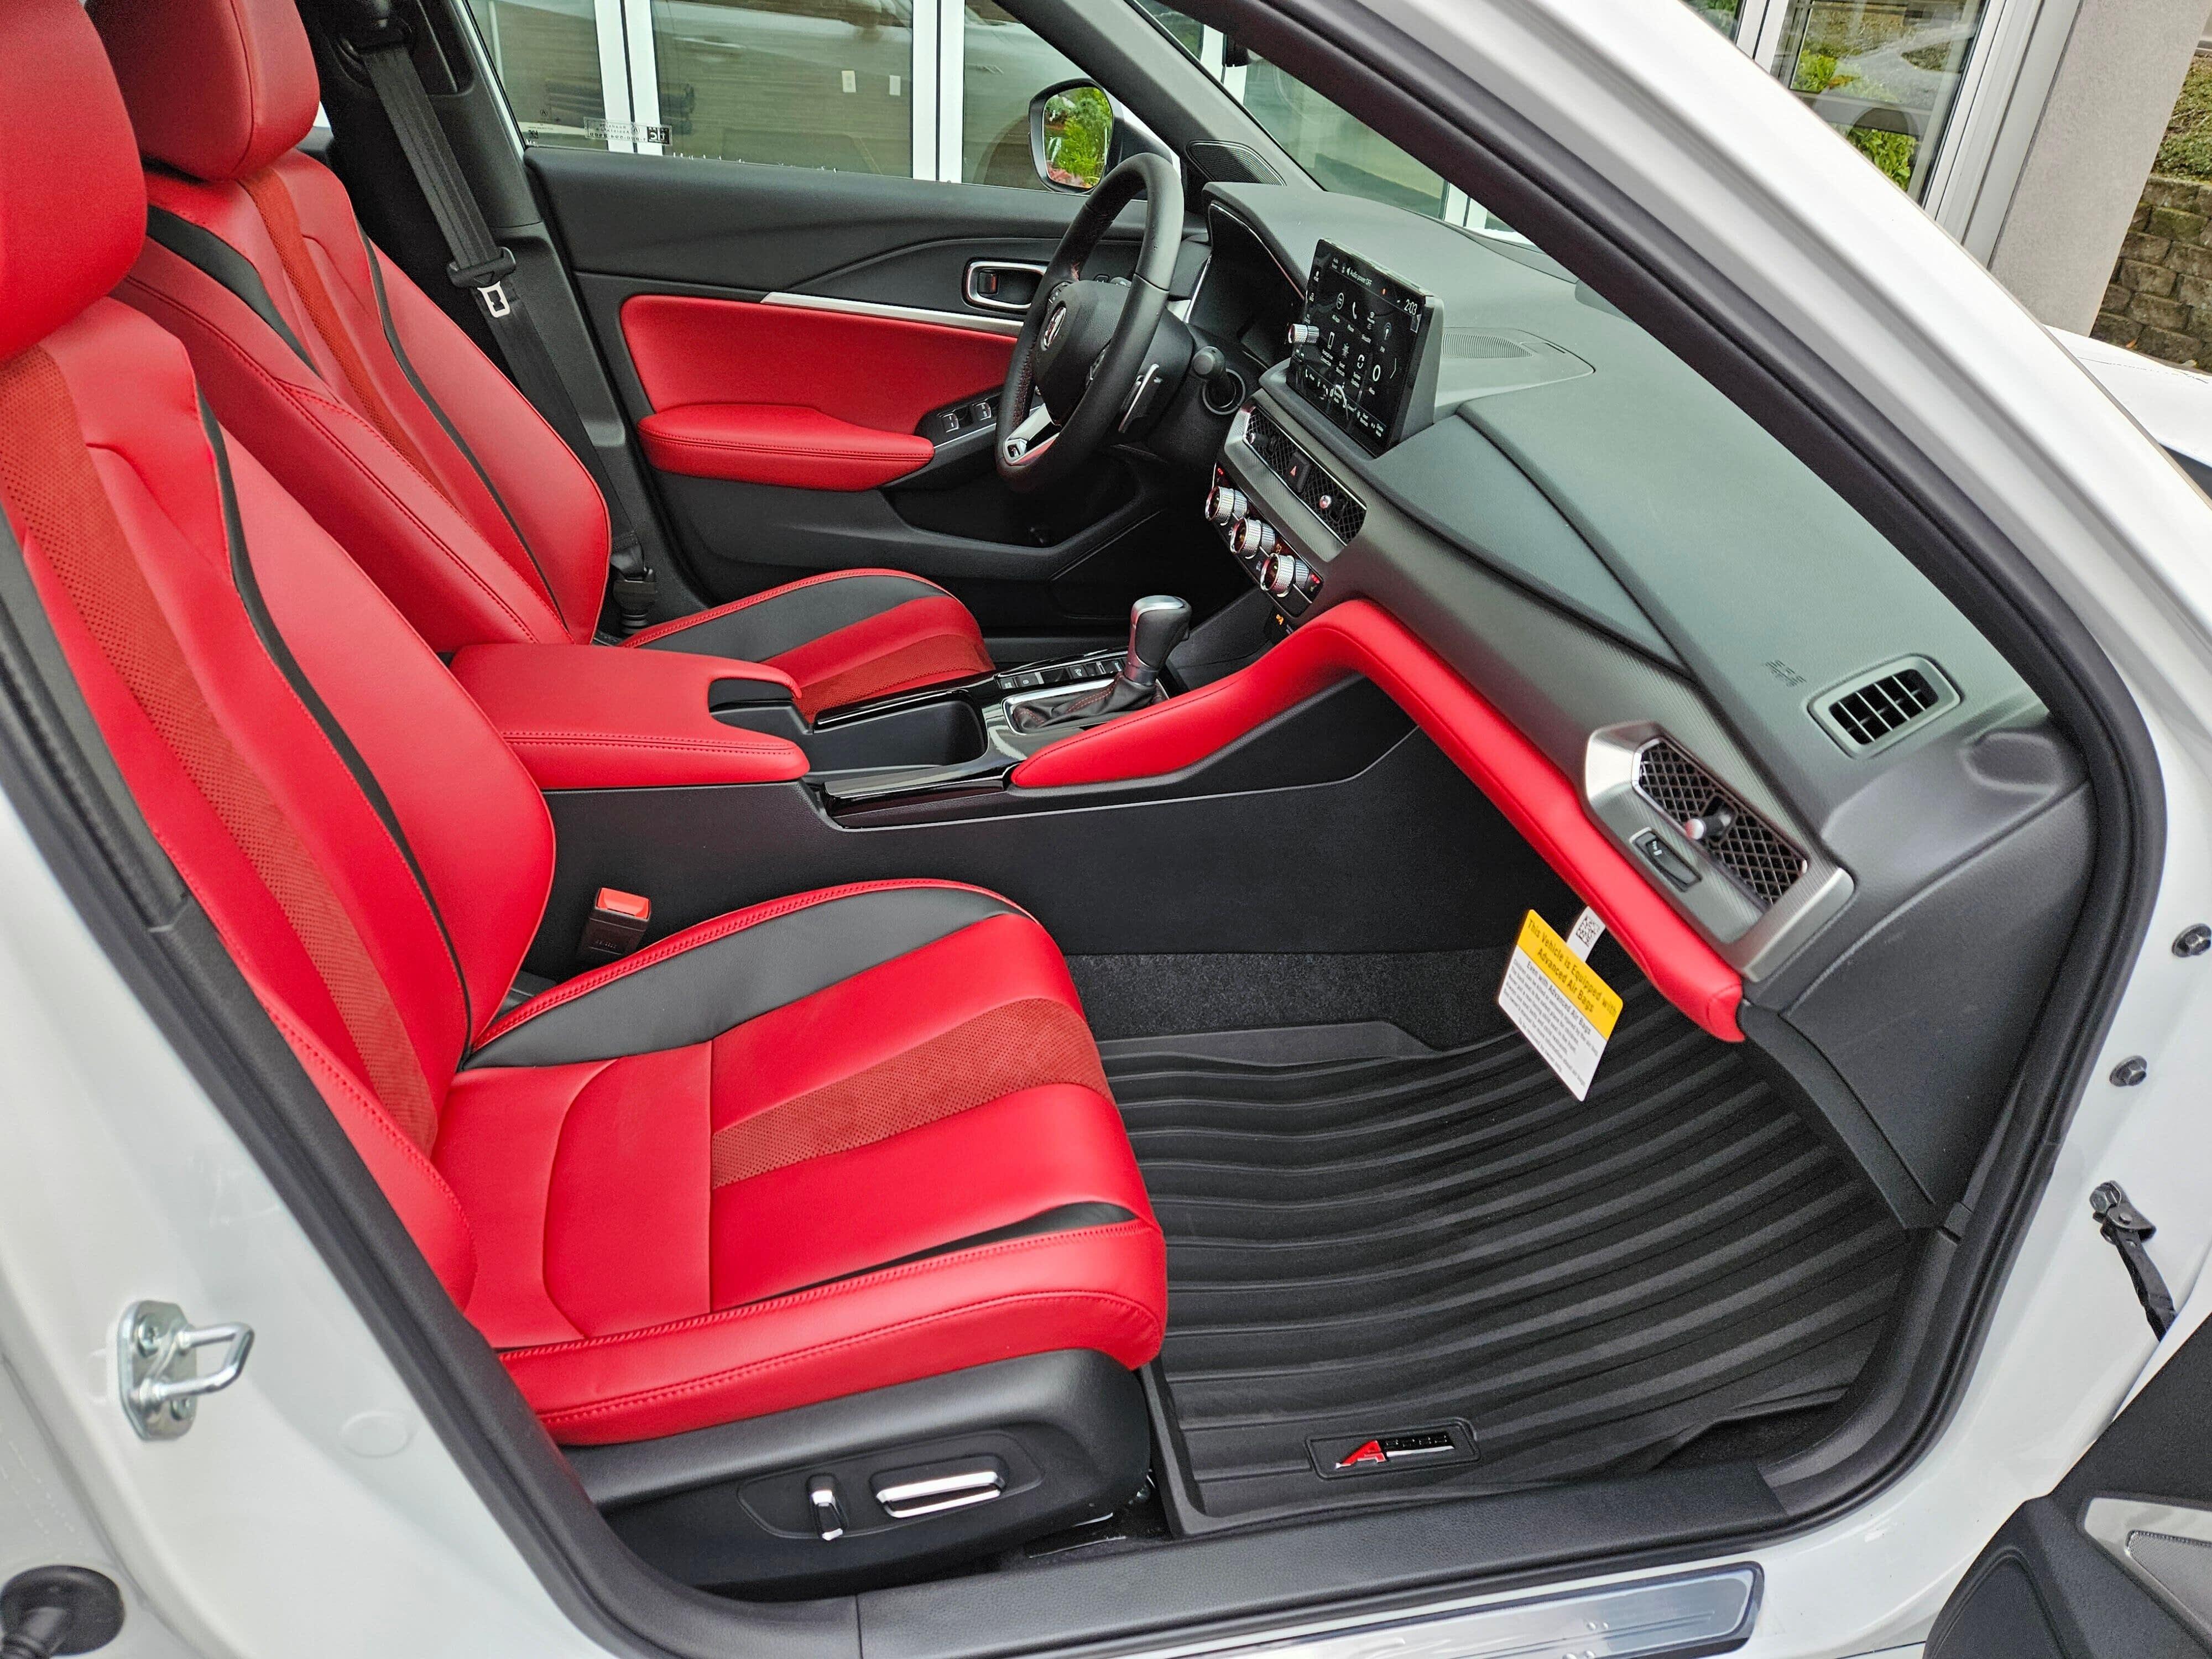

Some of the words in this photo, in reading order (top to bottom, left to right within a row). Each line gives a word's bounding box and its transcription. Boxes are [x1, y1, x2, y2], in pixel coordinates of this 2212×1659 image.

[1404, 299, 1417, 315] 2:03
[1526, 961, 1538, 978] Even
[1538, 973, 1548, 988] with
[1548, 983, 1571, 1013] Advanced
[1571, 1008, 1579, 1021] Air
[1578, 1017, 1592, 1036] Bags
[1527, 918, 1541, 938] This
[1540, 932, 1564, 963] Vehicle
[1563, 956, 1572, 970] is
[1570, 963, 1602, 1003] Equipped
[1601, 995, 1618, 1018] with
[1537, 946, 1568, 984] Advanced
[1567, 978, 1578, 995] Air
[1576, 989, 1595, 1015] Bags
